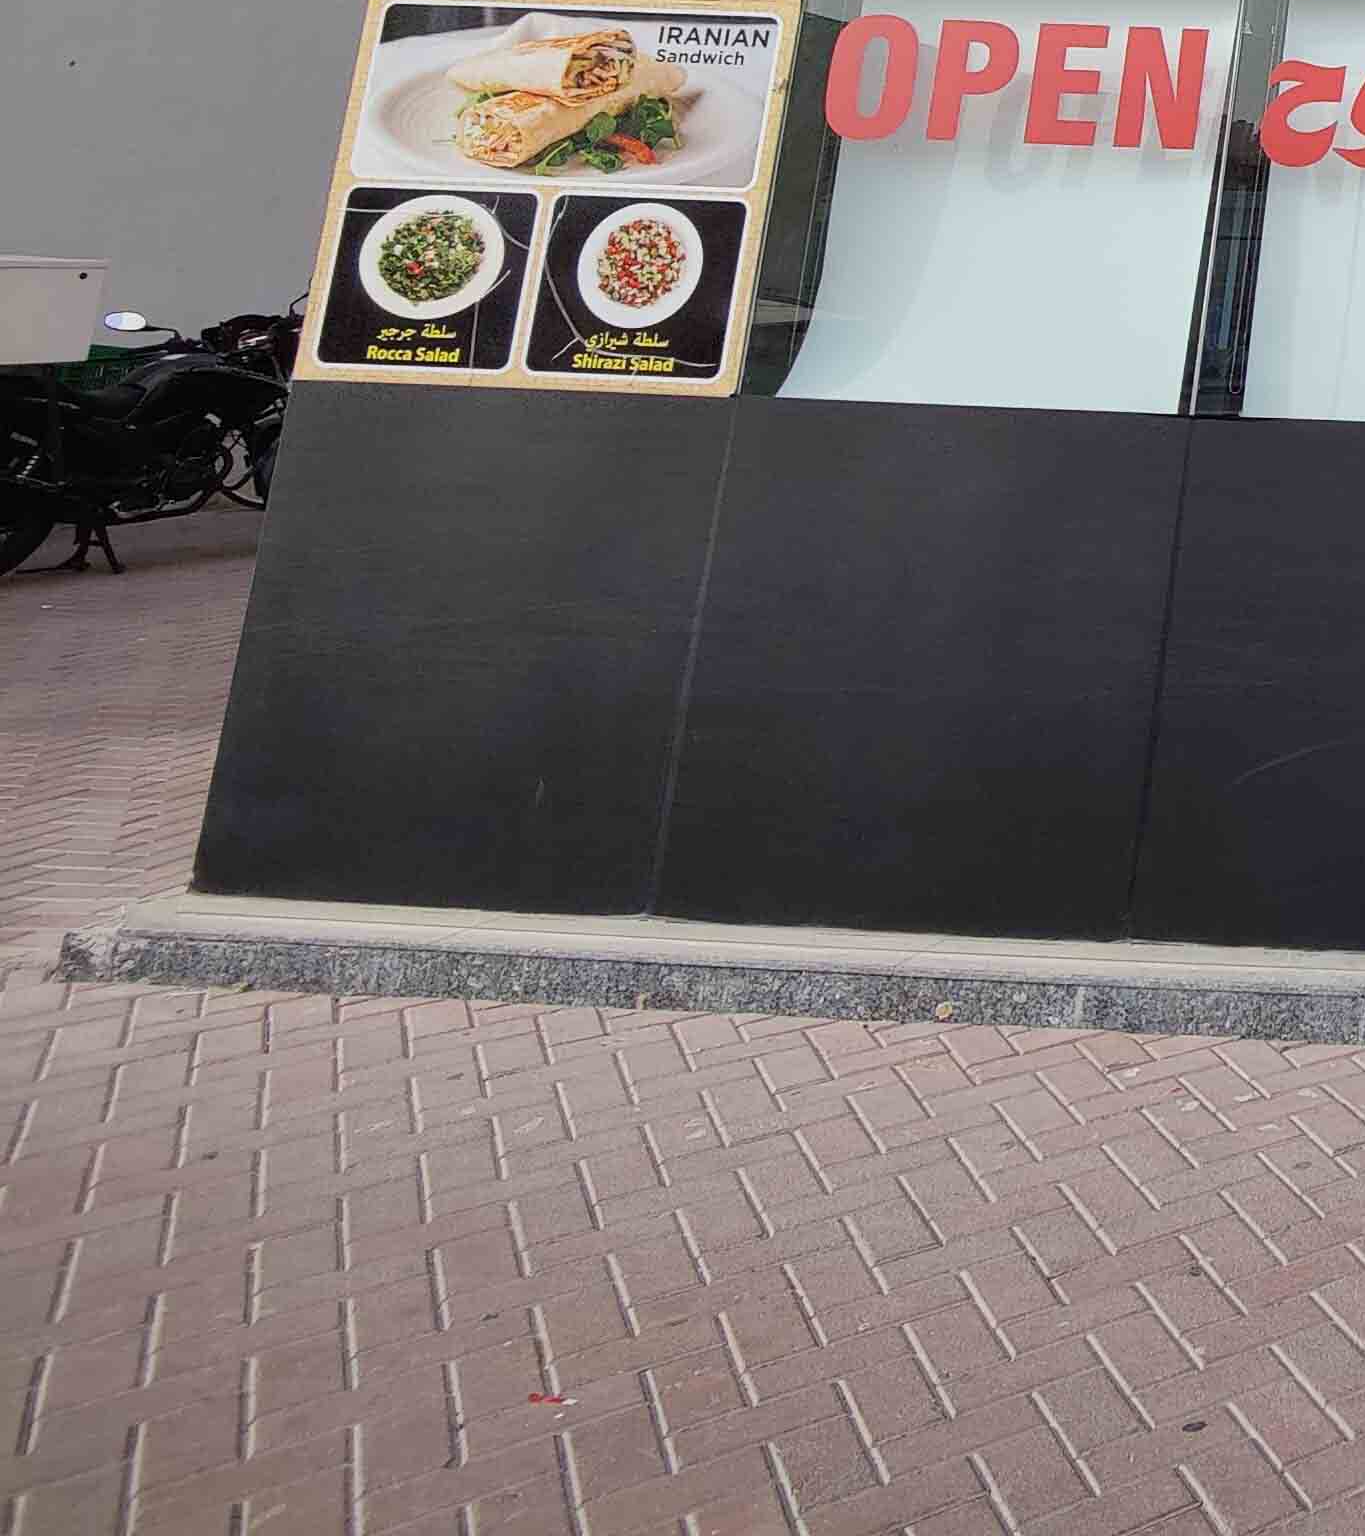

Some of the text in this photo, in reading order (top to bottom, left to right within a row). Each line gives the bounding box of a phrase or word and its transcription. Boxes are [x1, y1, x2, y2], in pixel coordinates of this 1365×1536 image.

[658, 26, 770, 48] IRANIAN
[656, 49, 744, 65] Sandwich
[824, 14, 1210, 151] OPEN
[420, 323, 457, 339] سلطة
[633, 331, 670, 348] سلطة
[366, 344, 460, 363] Rocca Salad
[572, 353, 674, 373] Shirazi Salad
